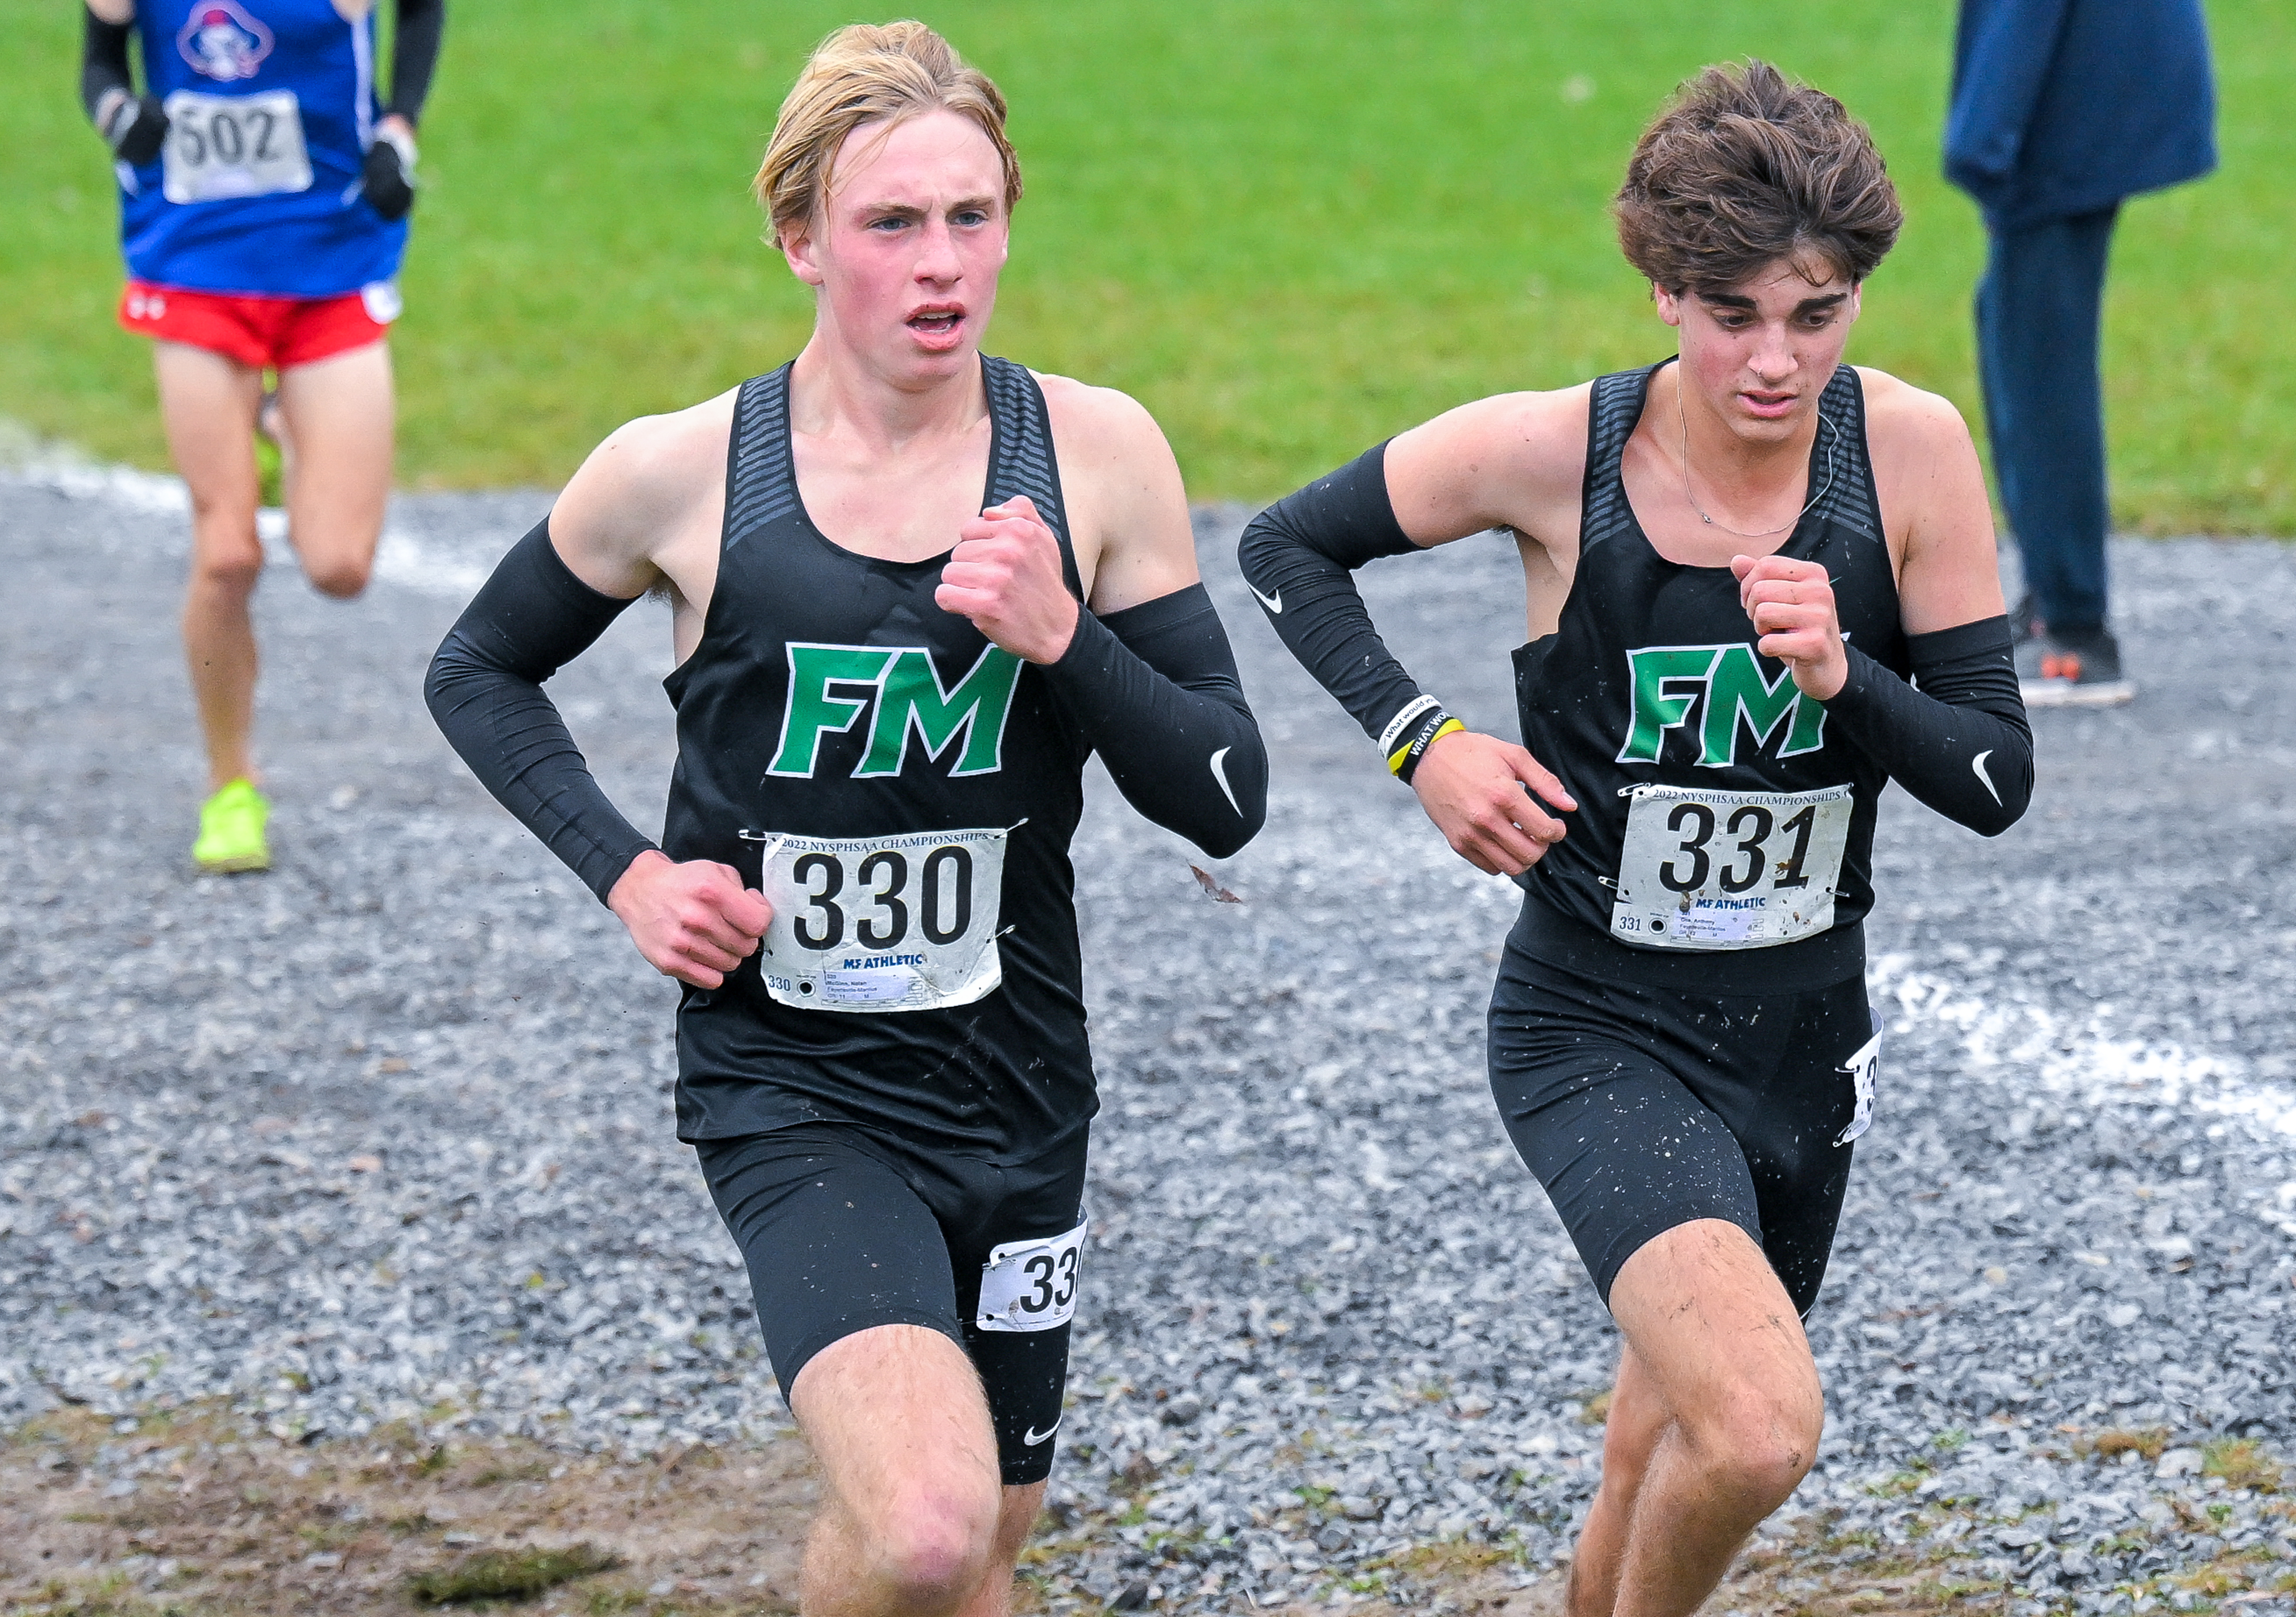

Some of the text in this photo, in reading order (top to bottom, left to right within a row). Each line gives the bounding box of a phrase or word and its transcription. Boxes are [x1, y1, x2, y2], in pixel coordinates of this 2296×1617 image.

[180, 107, 278, 166] 502
[765, 641, 1025, 779] FM
[1615, 632, 1851, 768] FM
[1385, 717, 1404, 738] What
[1403, 700, 1425, 719] would
[1410, 725, 1434, 756] WHAT
[1654, 789, 1841, 805] 2022 NYSPHSAA CHAMPIONSHIPS
[782, 833, 989, 852] 2022 NYSPHSAA CHAMPIONSHIPS
[1659, 803, 1817, 892] 331
[793, 846, 974, 950] 330
[1714, 897, 1766, 910] ATHLETIC
[1619, 916, 1641, 931] 331
[863, 954, 923, 969] ATHLETIC
[768, 976, 791, 992] 330
